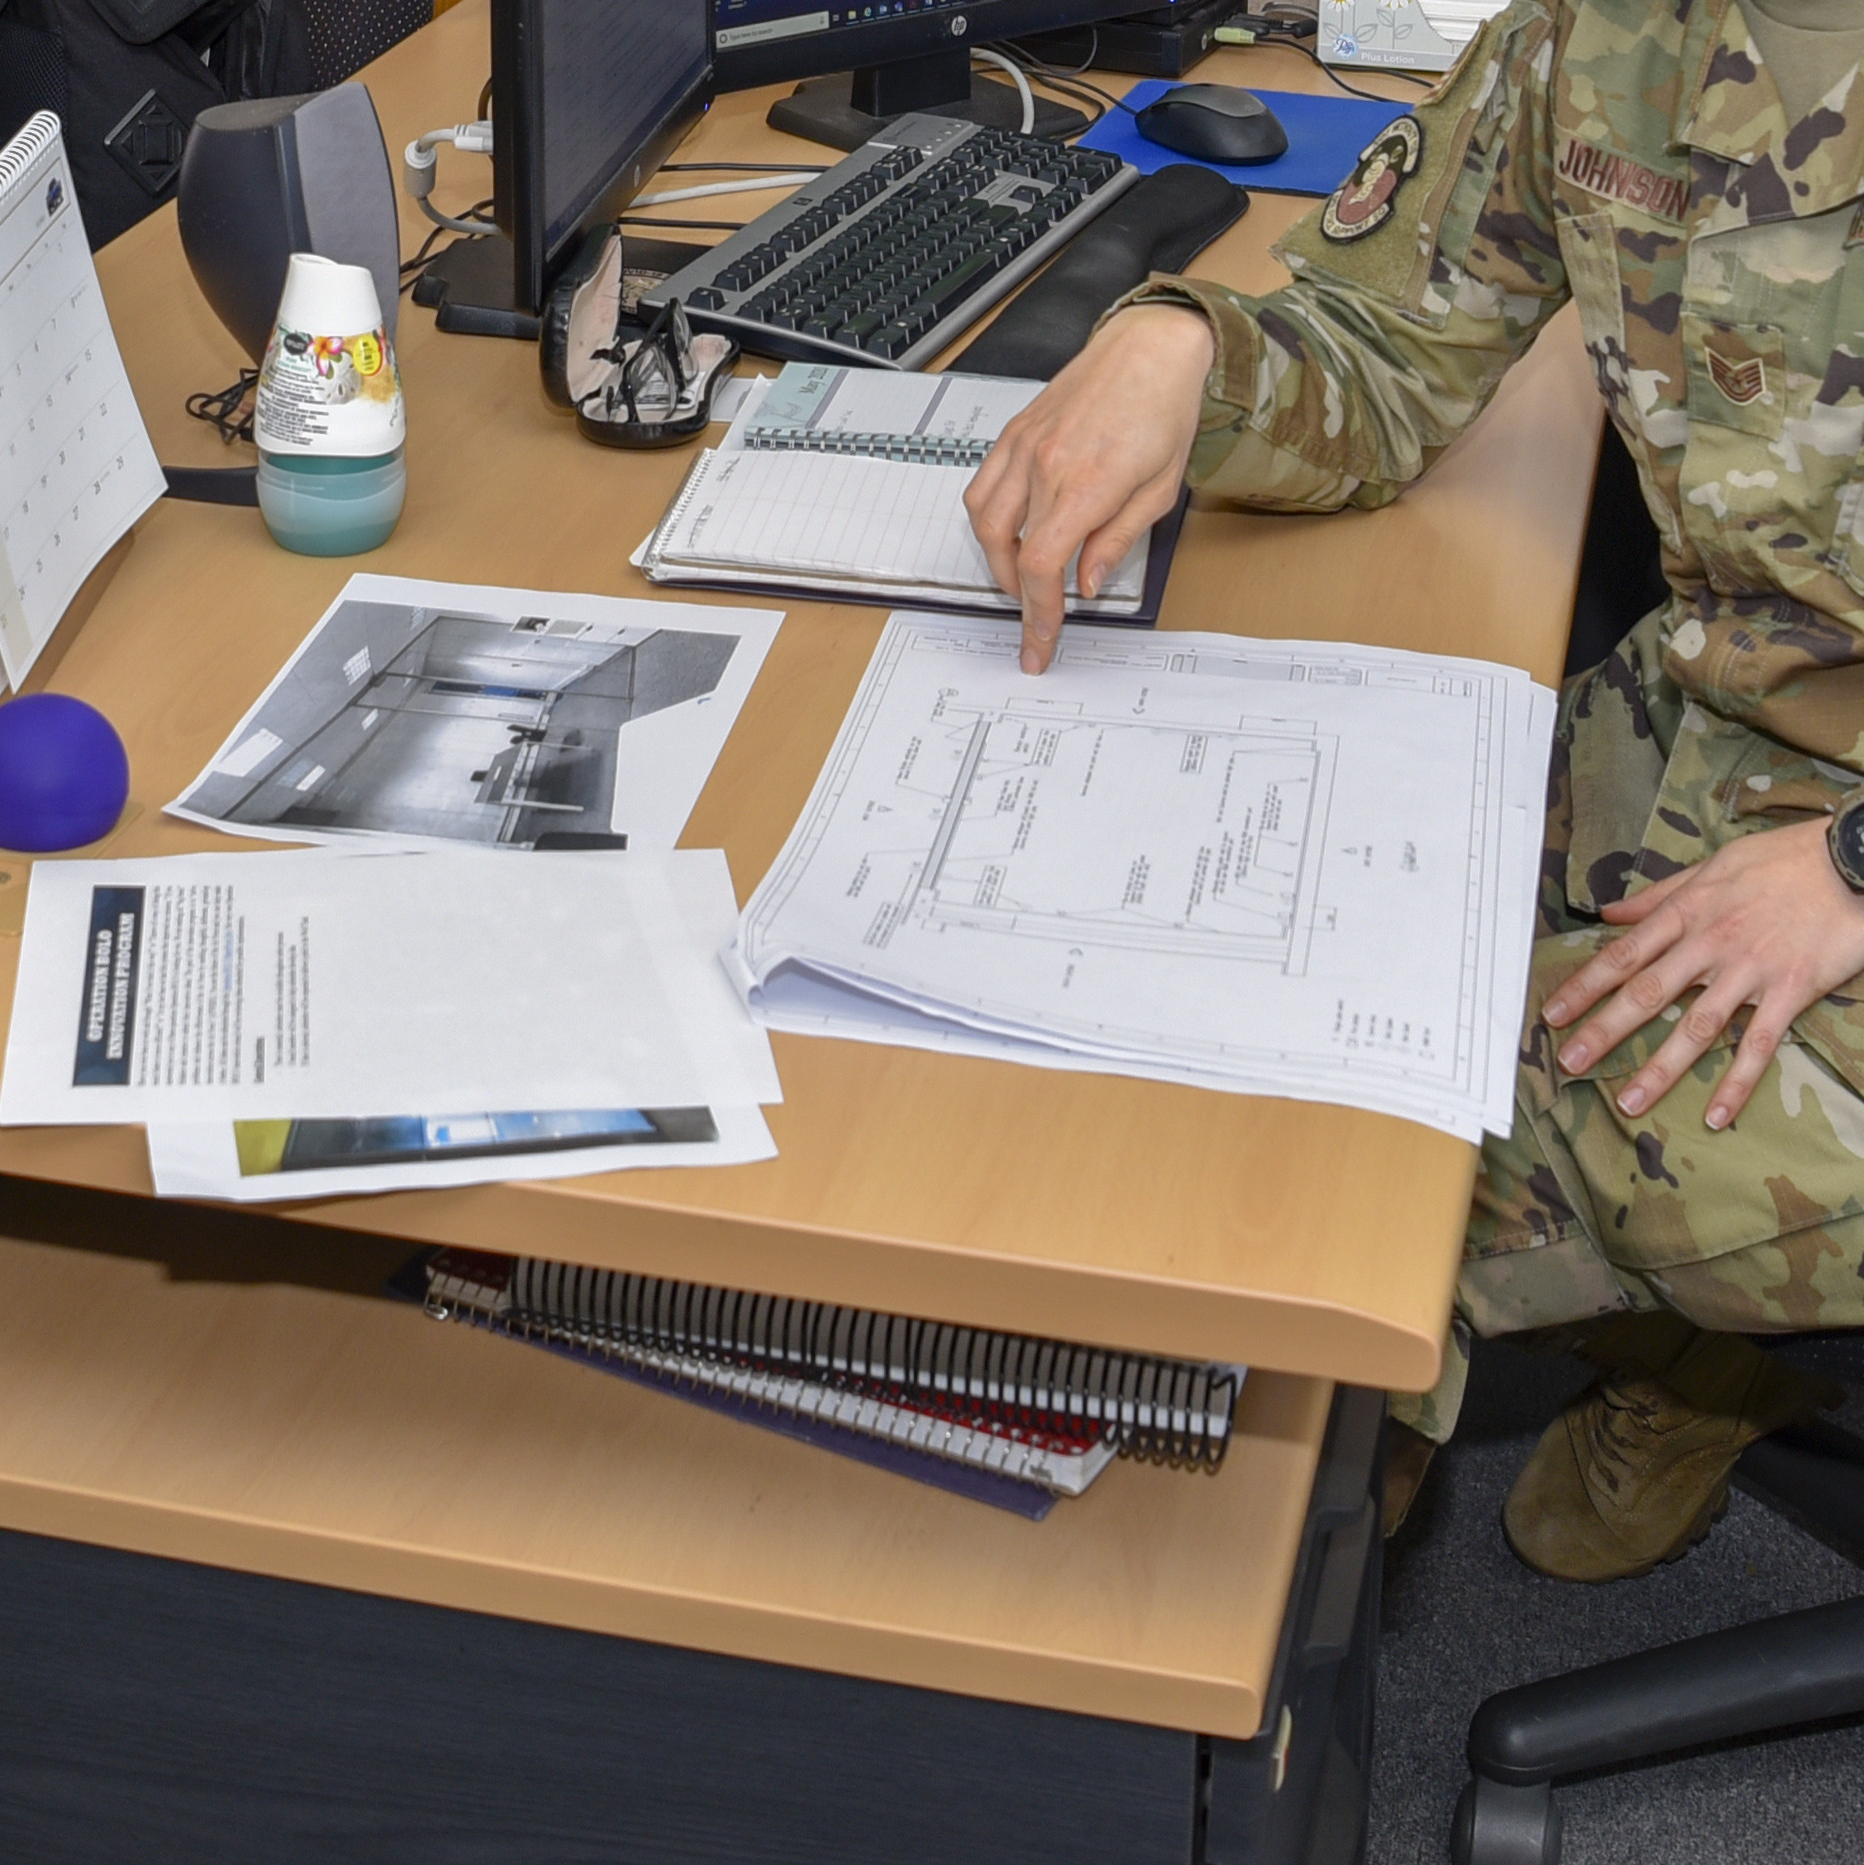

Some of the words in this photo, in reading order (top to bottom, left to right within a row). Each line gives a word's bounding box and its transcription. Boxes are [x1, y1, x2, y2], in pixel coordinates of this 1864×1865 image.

[1361, 52, 1382, 62] Plus
[1384, 54, 1415, 64] Lotion
[1559, 139, 1689, 222] JOHNSON
